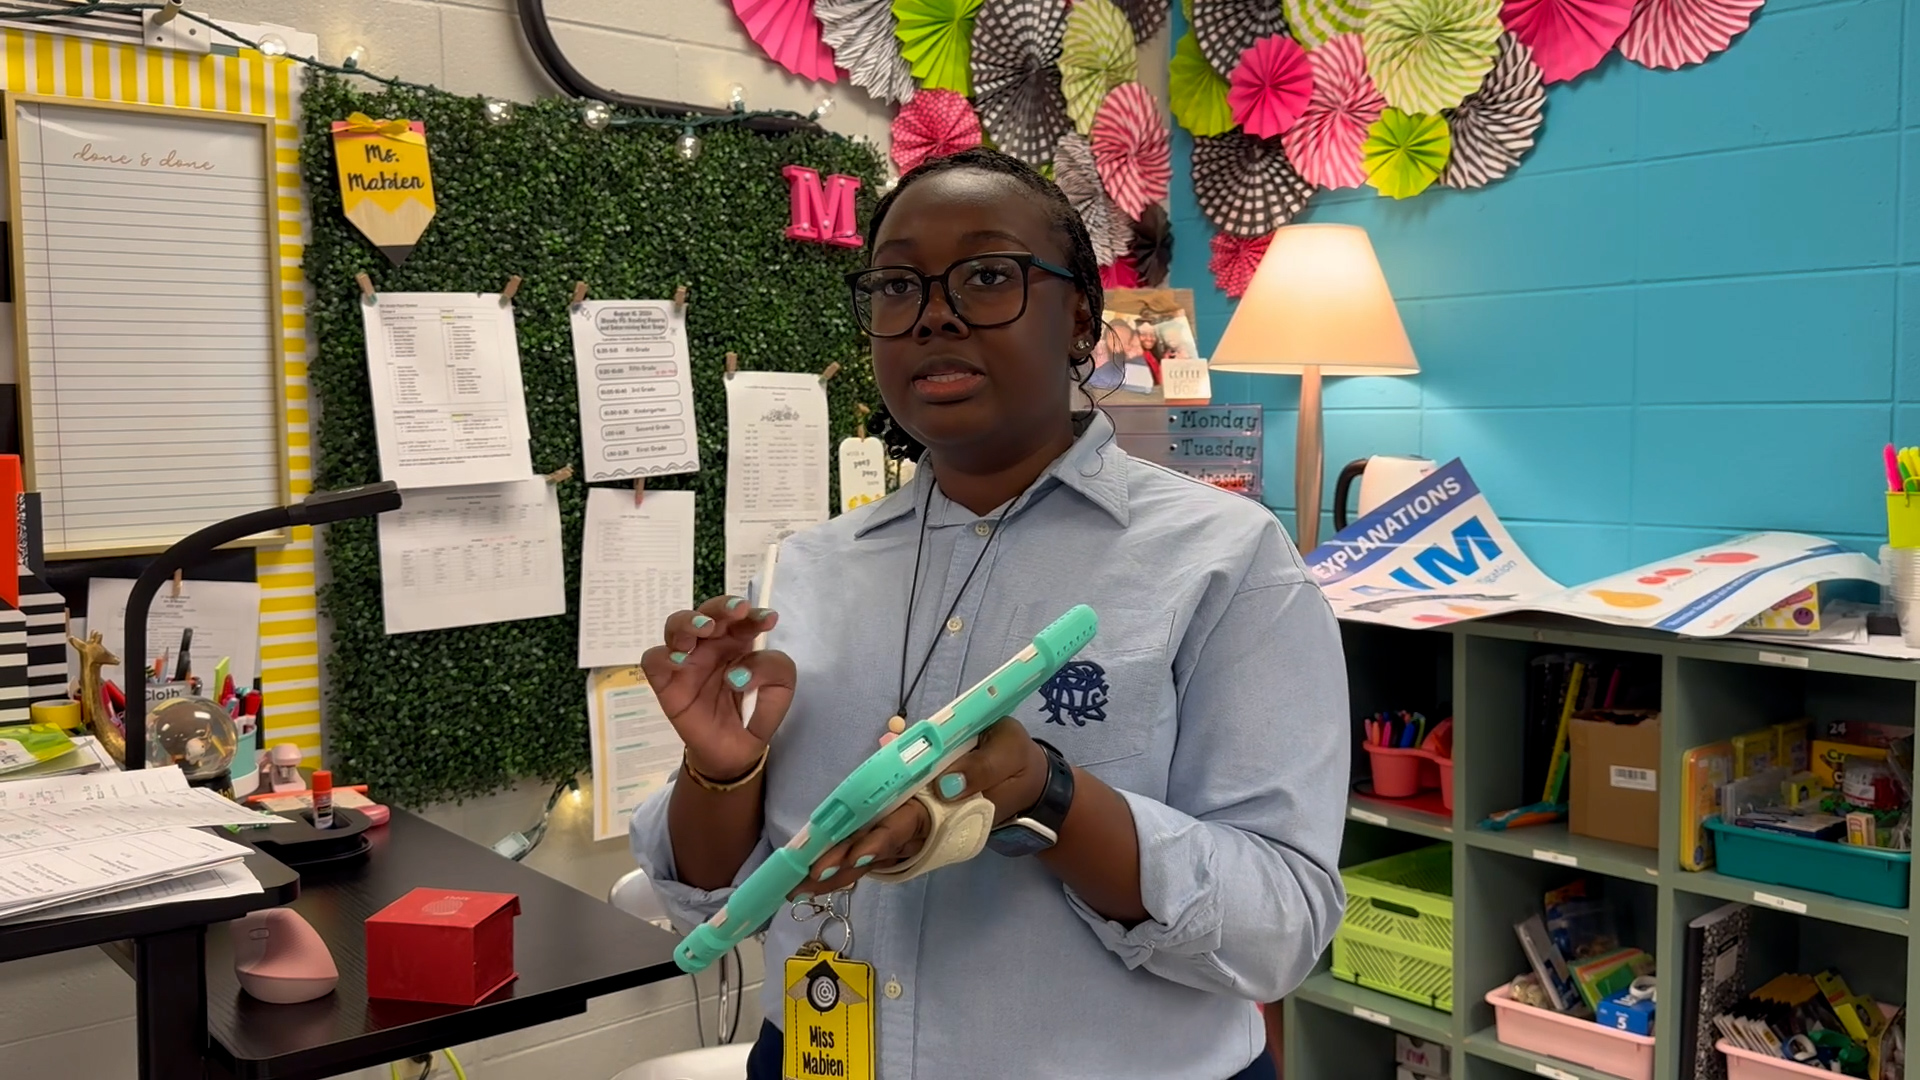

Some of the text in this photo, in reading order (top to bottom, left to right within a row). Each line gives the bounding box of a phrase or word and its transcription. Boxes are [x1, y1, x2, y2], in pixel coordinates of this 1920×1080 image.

[73, 143, 133, 165] done
[159, 150, 216, 171] done
[365, 144, 400, 163] Ms.
[347, 171, 425, 192] Mabien
[782, 164, 865, 248] M
[1180, 409, 1258, 432] Monday
[1181, 438, 1256, 461] Tuesday
[1311, 476, 1462, 580] EXPLANATIONS
[144, 687, 180, 701] Cloth
[1829, 722, 1847, 735] 24
[1616, 1016, 1627, 1030] 5
[808, 1025, 835, 1049] Miss
[802, 1051, 844, 1077] Mabien
